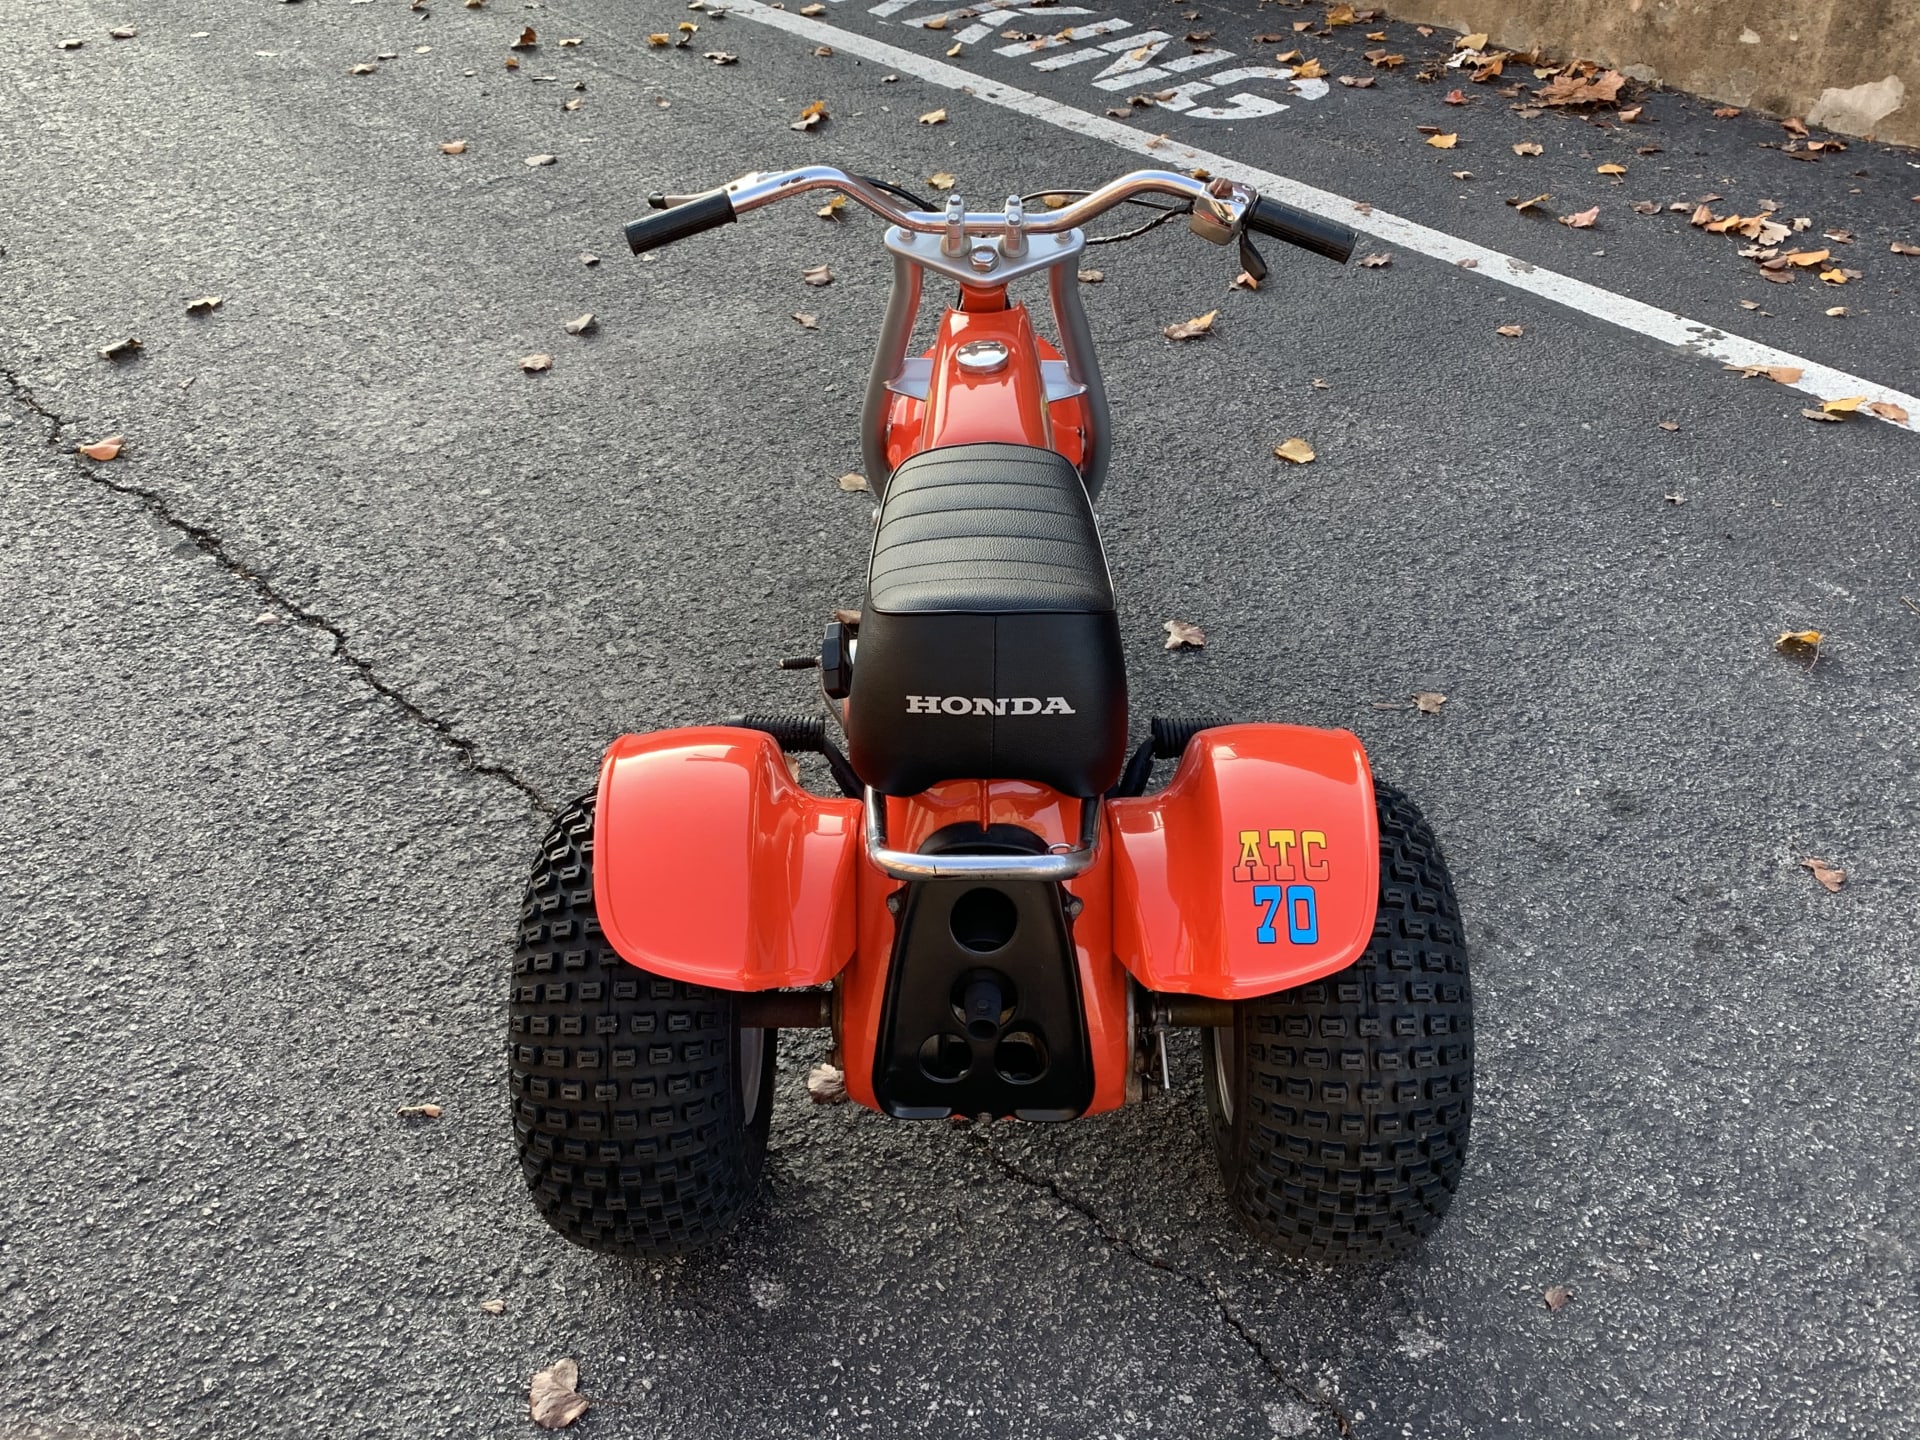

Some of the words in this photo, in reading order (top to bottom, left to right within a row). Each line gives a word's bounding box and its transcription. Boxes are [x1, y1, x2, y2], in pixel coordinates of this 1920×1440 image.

[867, 0, 1330, 120] KING
[906, 695, 1076, 716] HONDA
[1233, 829, 1330, 882] ATC
[1253, 885, 1319, 945] 70
